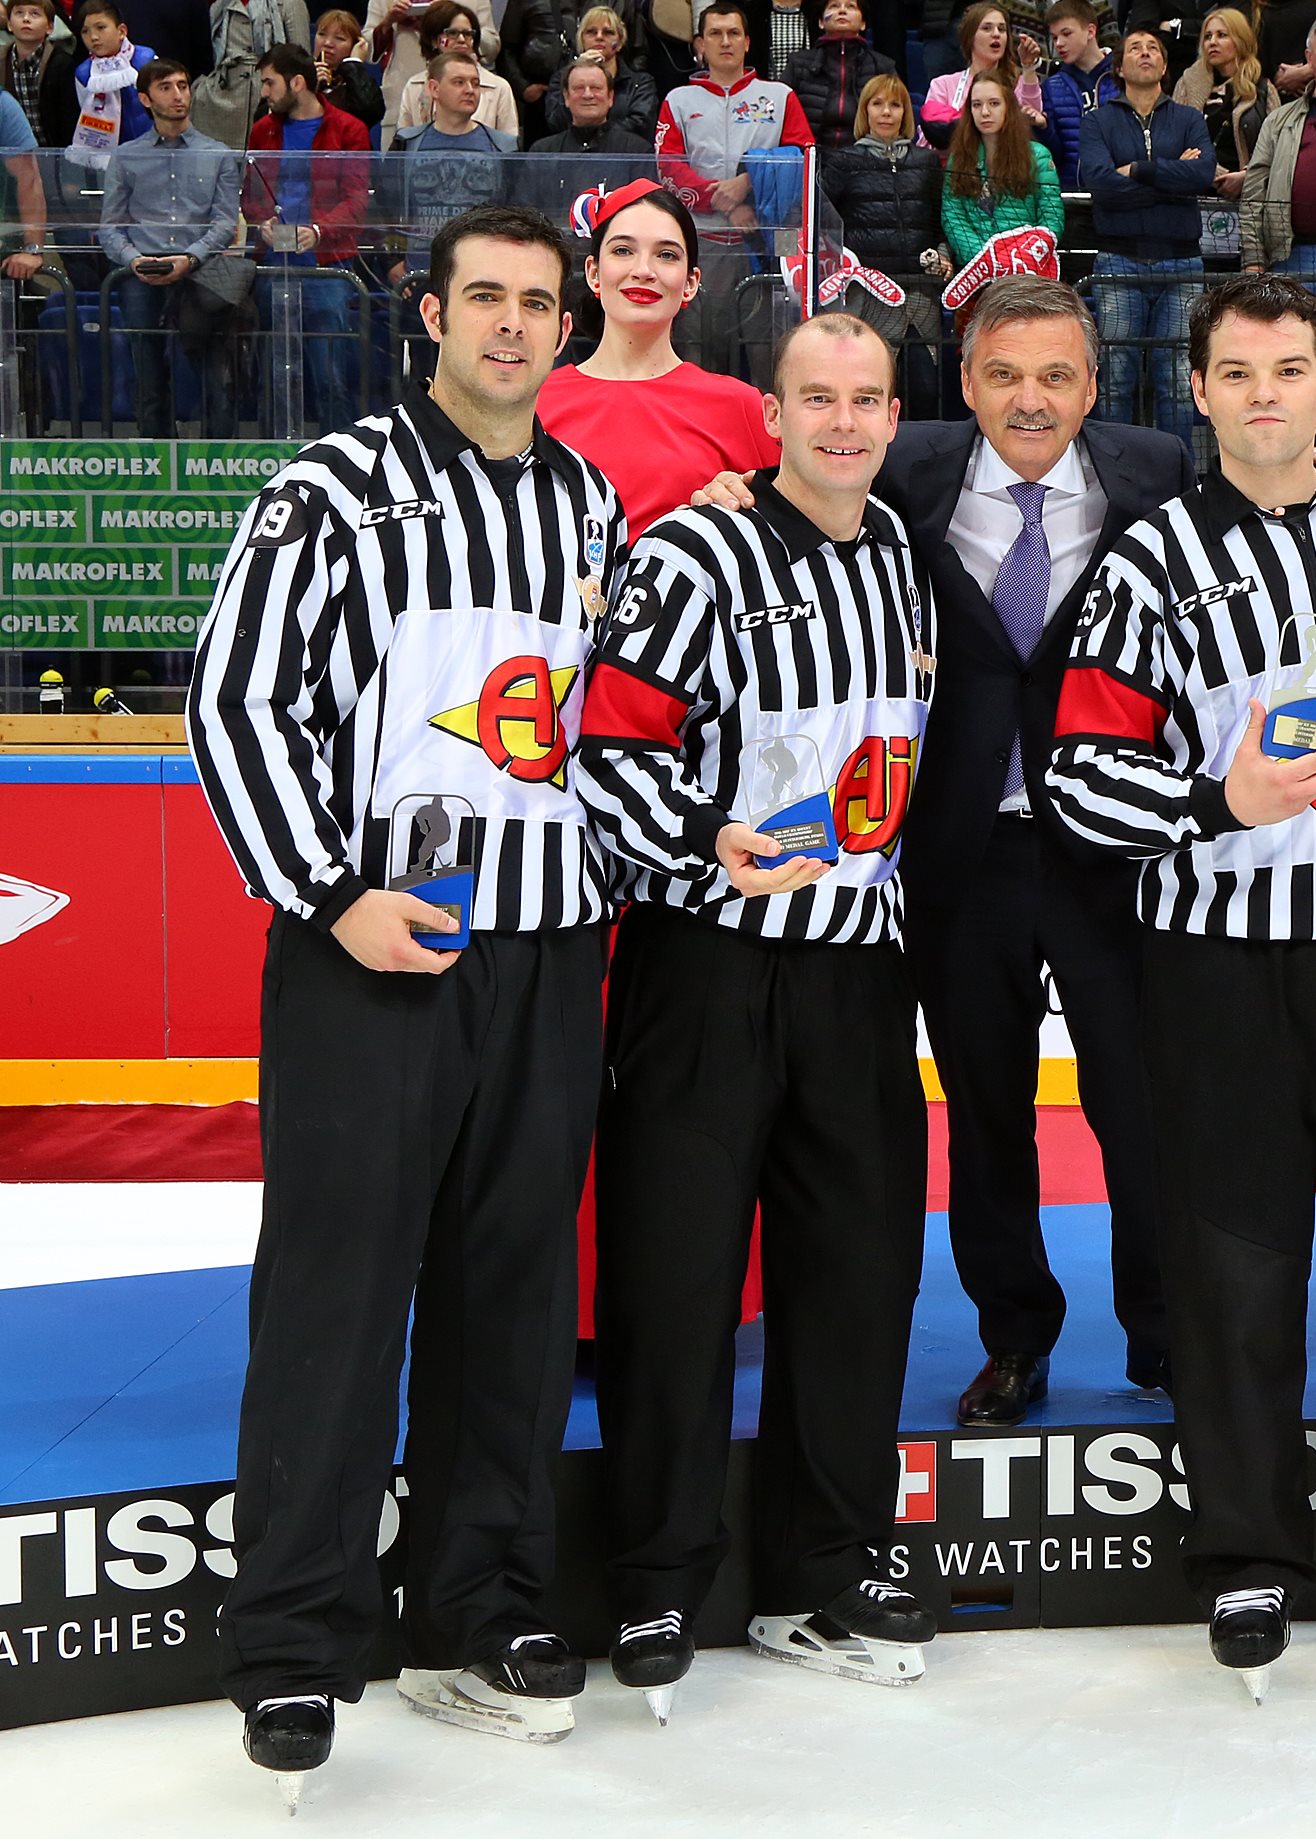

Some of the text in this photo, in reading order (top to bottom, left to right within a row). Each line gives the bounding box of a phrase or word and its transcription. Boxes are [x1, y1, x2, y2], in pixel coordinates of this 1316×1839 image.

[953, 261, 989, 301] CANADA
[9, 457, 162, 476] MAKROFLEX
[0, 510, 77, 528] OFLEX
[361, 501, 441, 526] CCM
[12, 563, 163, 581] MAKROFLEX
[1175, 578, 1252, 617] CCM
[2, 615, 80, 633] OFLEX
[740, 603, 812, 629] CCM
[935, 1535, 1153, 1577] WATCHES
[0, 1608, 186, 1667] ATCHES
